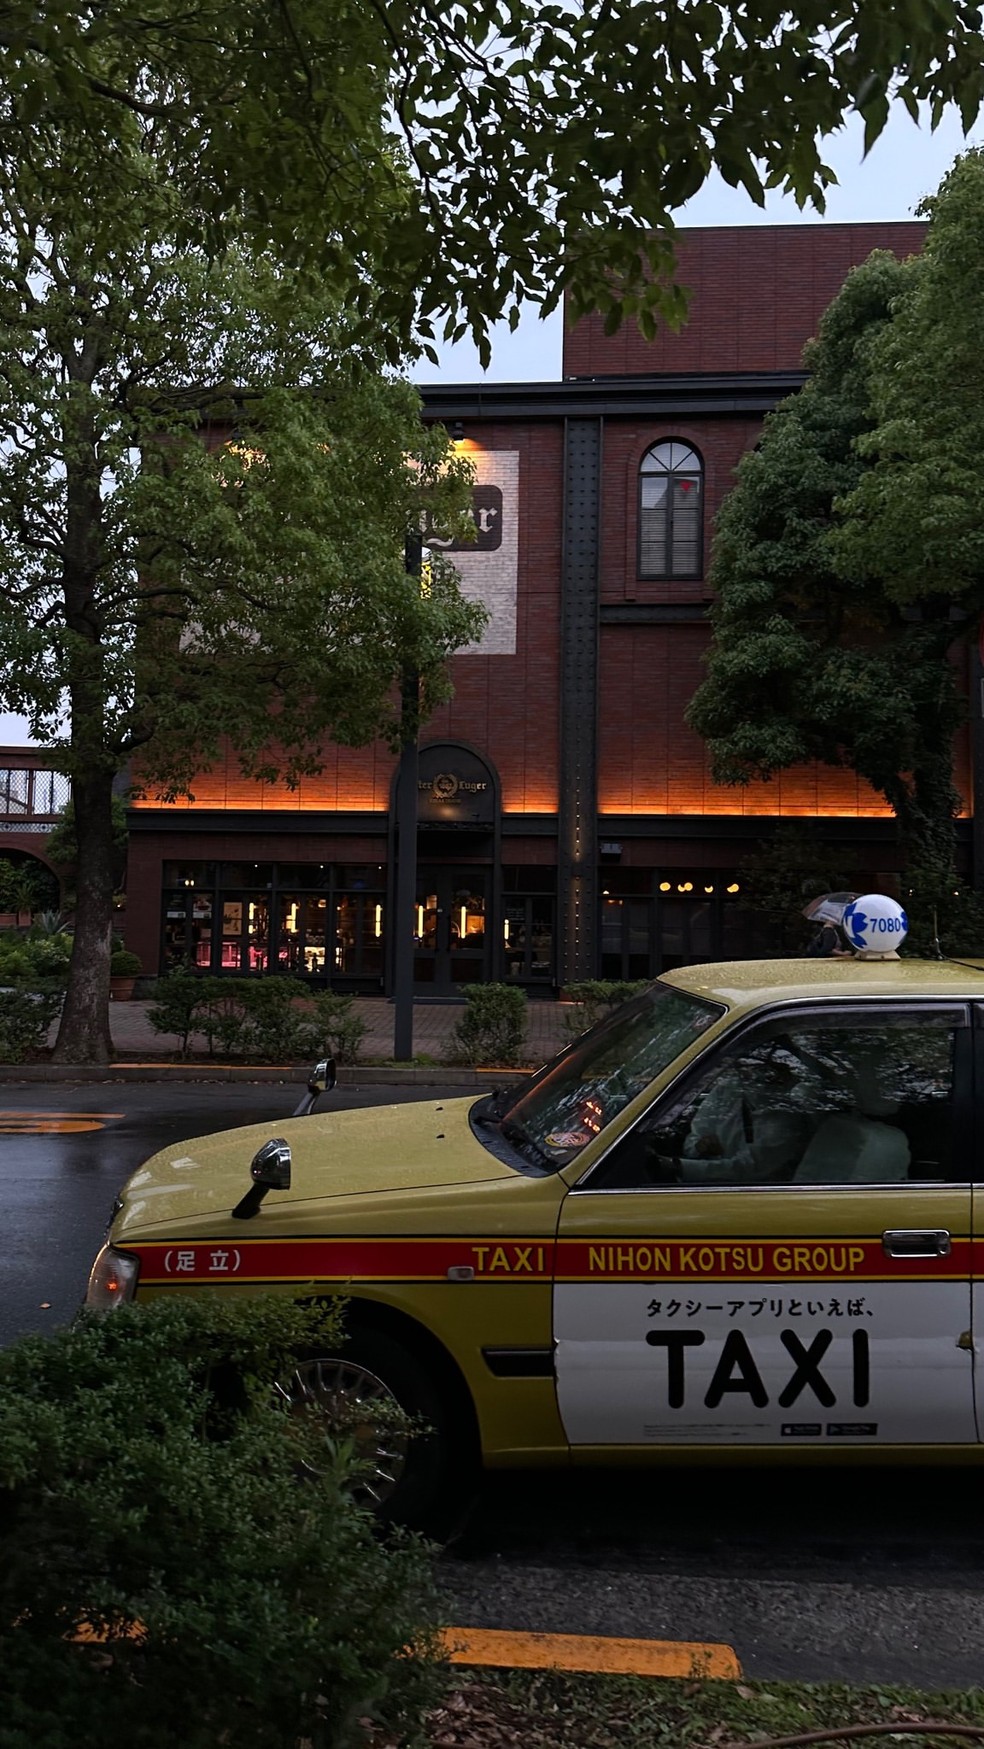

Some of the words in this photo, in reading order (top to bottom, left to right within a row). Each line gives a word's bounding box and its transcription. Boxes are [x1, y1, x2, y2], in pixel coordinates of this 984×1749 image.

[459, 781, 487, 792] Luger
[870, 918, 901, 933] 7080
[472, 1247, 545, 1273] TAXI
[588, 1247, 672, 1272] NIHON
[679, 1247, 764, 1272] KOTSU
[772, 1246, 865, 1272] GROUP
[647, 1298, 875, 1318] タクシーアプリといえば、
[646, 1328, 869, 1409] TAXI
